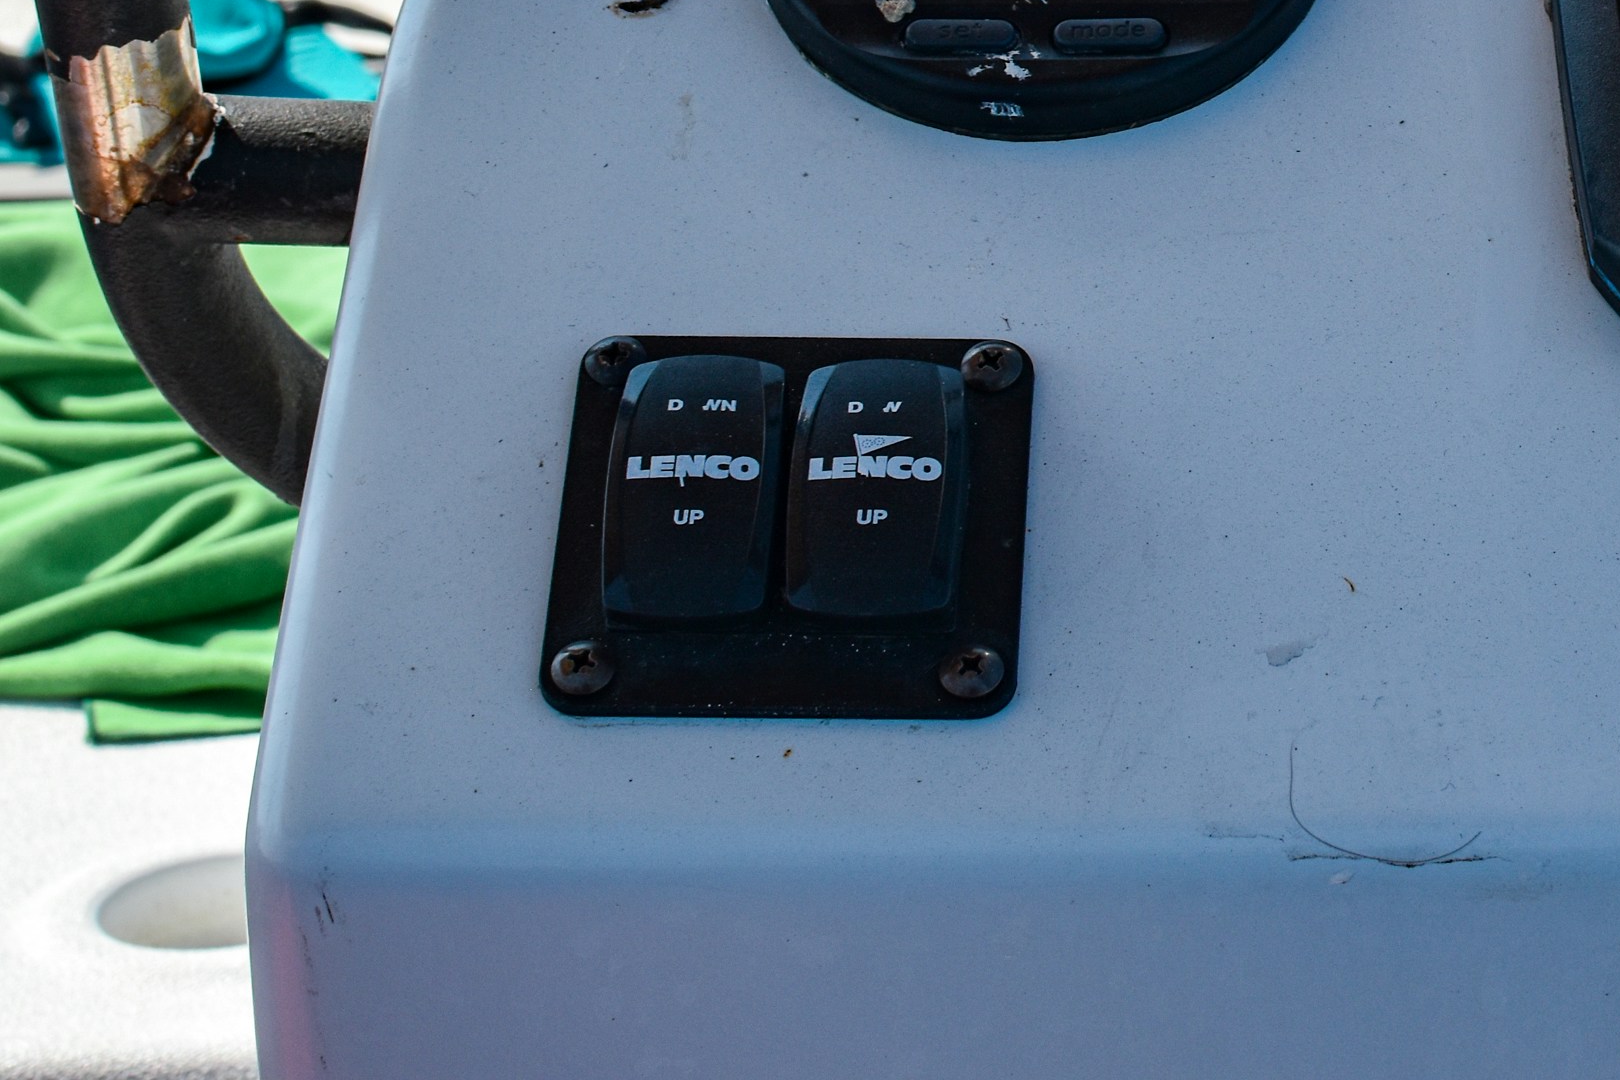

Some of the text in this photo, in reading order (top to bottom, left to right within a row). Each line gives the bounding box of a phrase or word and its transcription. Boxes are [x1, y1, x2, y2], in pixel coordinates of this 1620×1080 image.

[938, 21, 984, 40] set
[1070, 20, 1147, 40] mode
[667, 398, 737, 413] DWN
[626, 454, 760, 482] LENCO
[808, 455, 943, 482] LENCO
[673, 508, 705, 526] UP
[856, 508, 889, 526] UP
